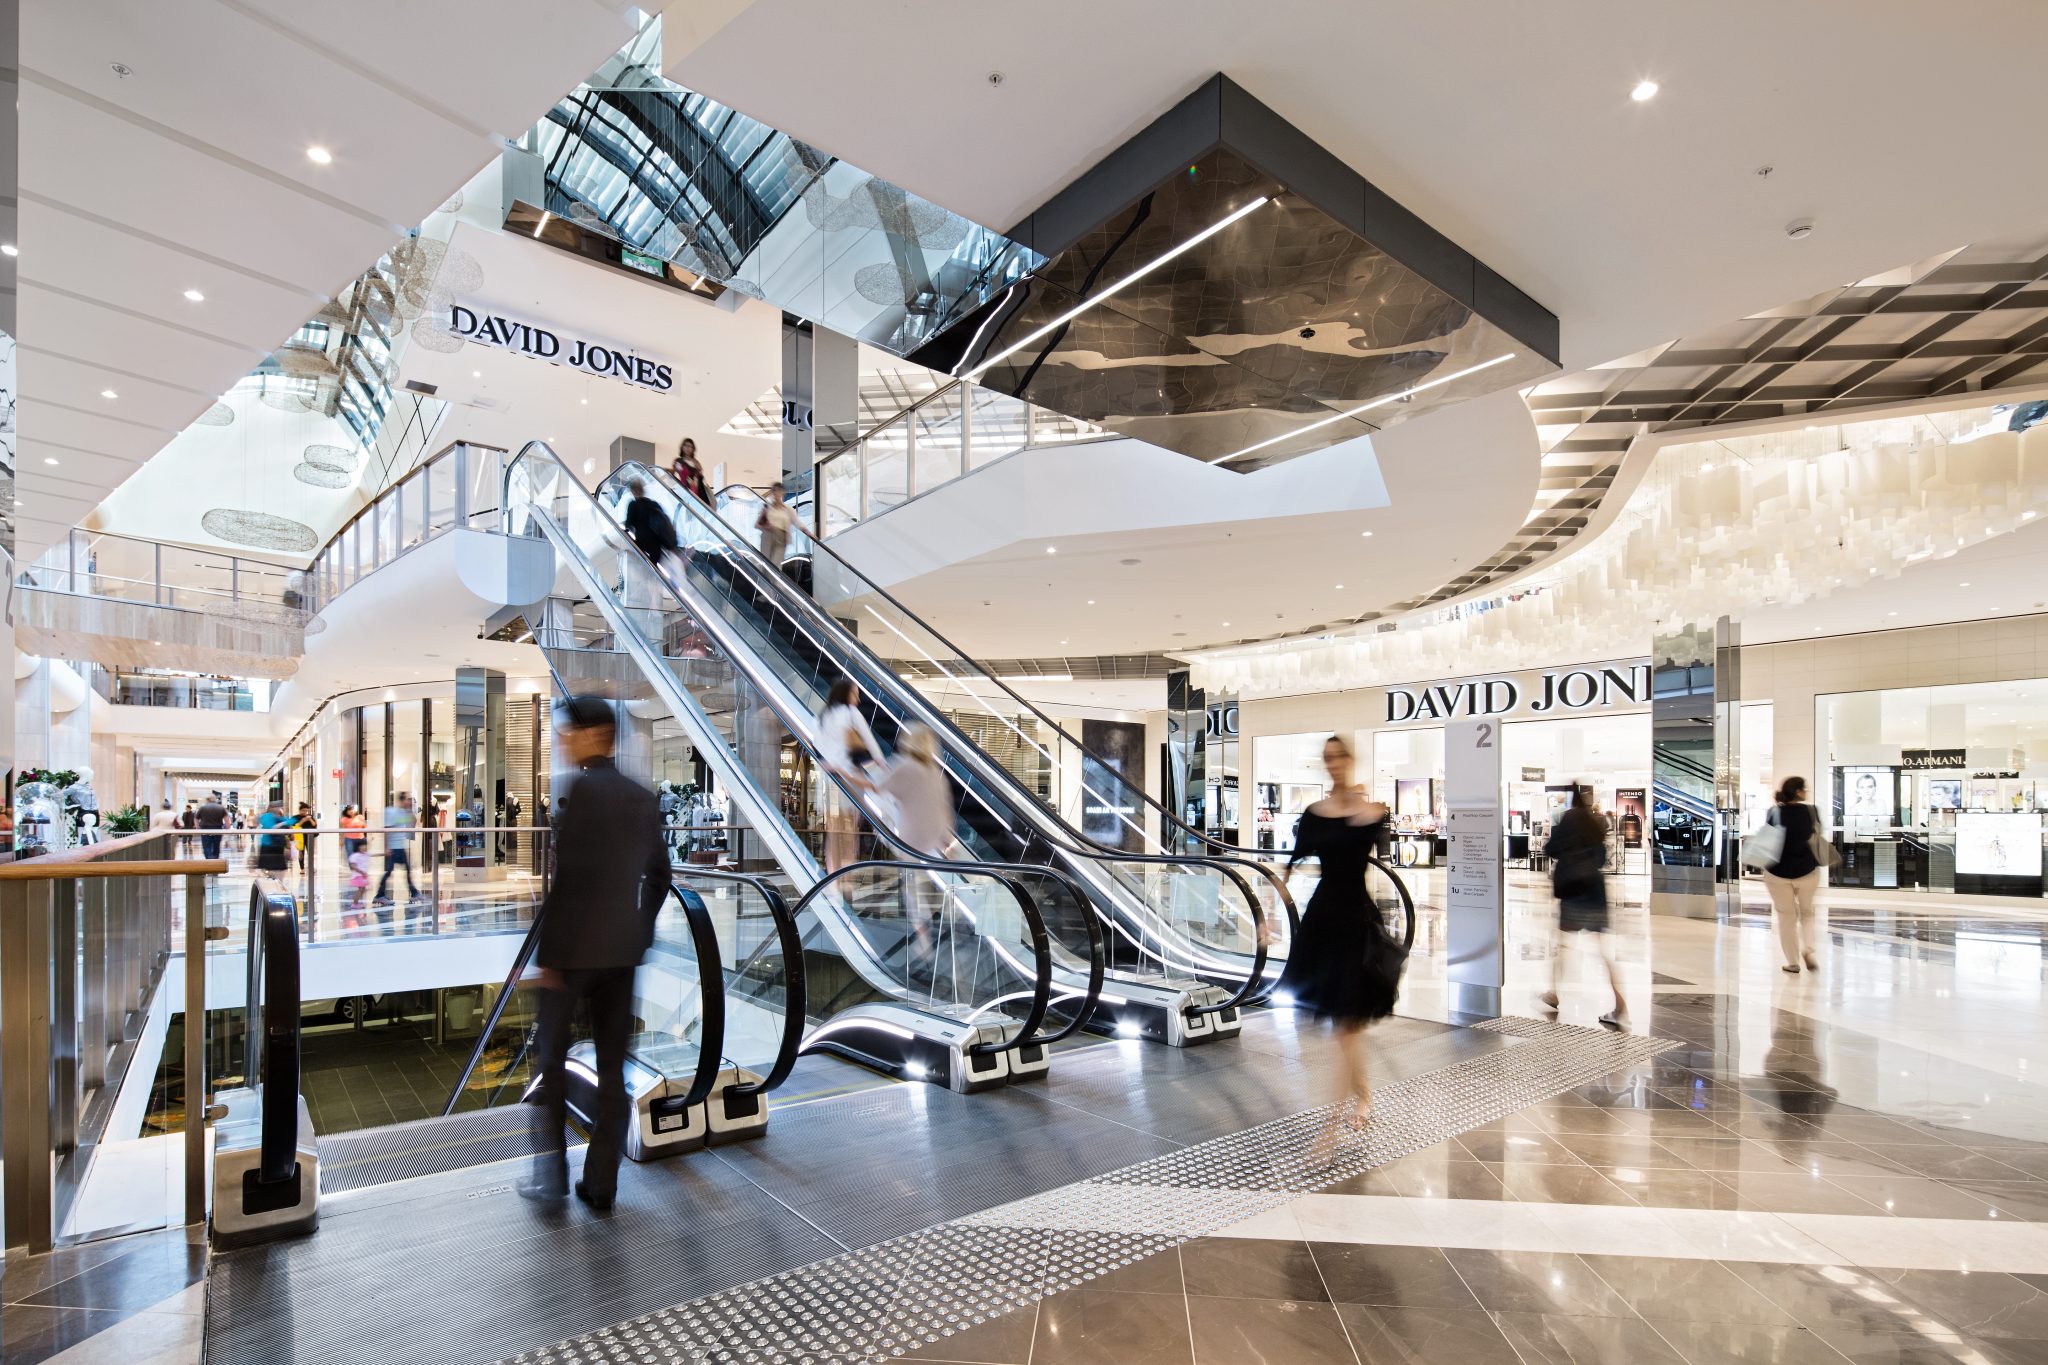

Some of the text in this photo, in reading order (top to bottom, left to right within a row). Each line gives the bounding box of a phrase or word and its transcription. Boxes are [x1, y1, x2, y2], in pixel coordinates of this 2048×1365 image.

[450, 304, 673, 390] DAVID JONES
[1385, 680, 1518, 722] DAVID
[1476, 723, 1492, 748] 2
[1451, 813, 1456, 821] 4
